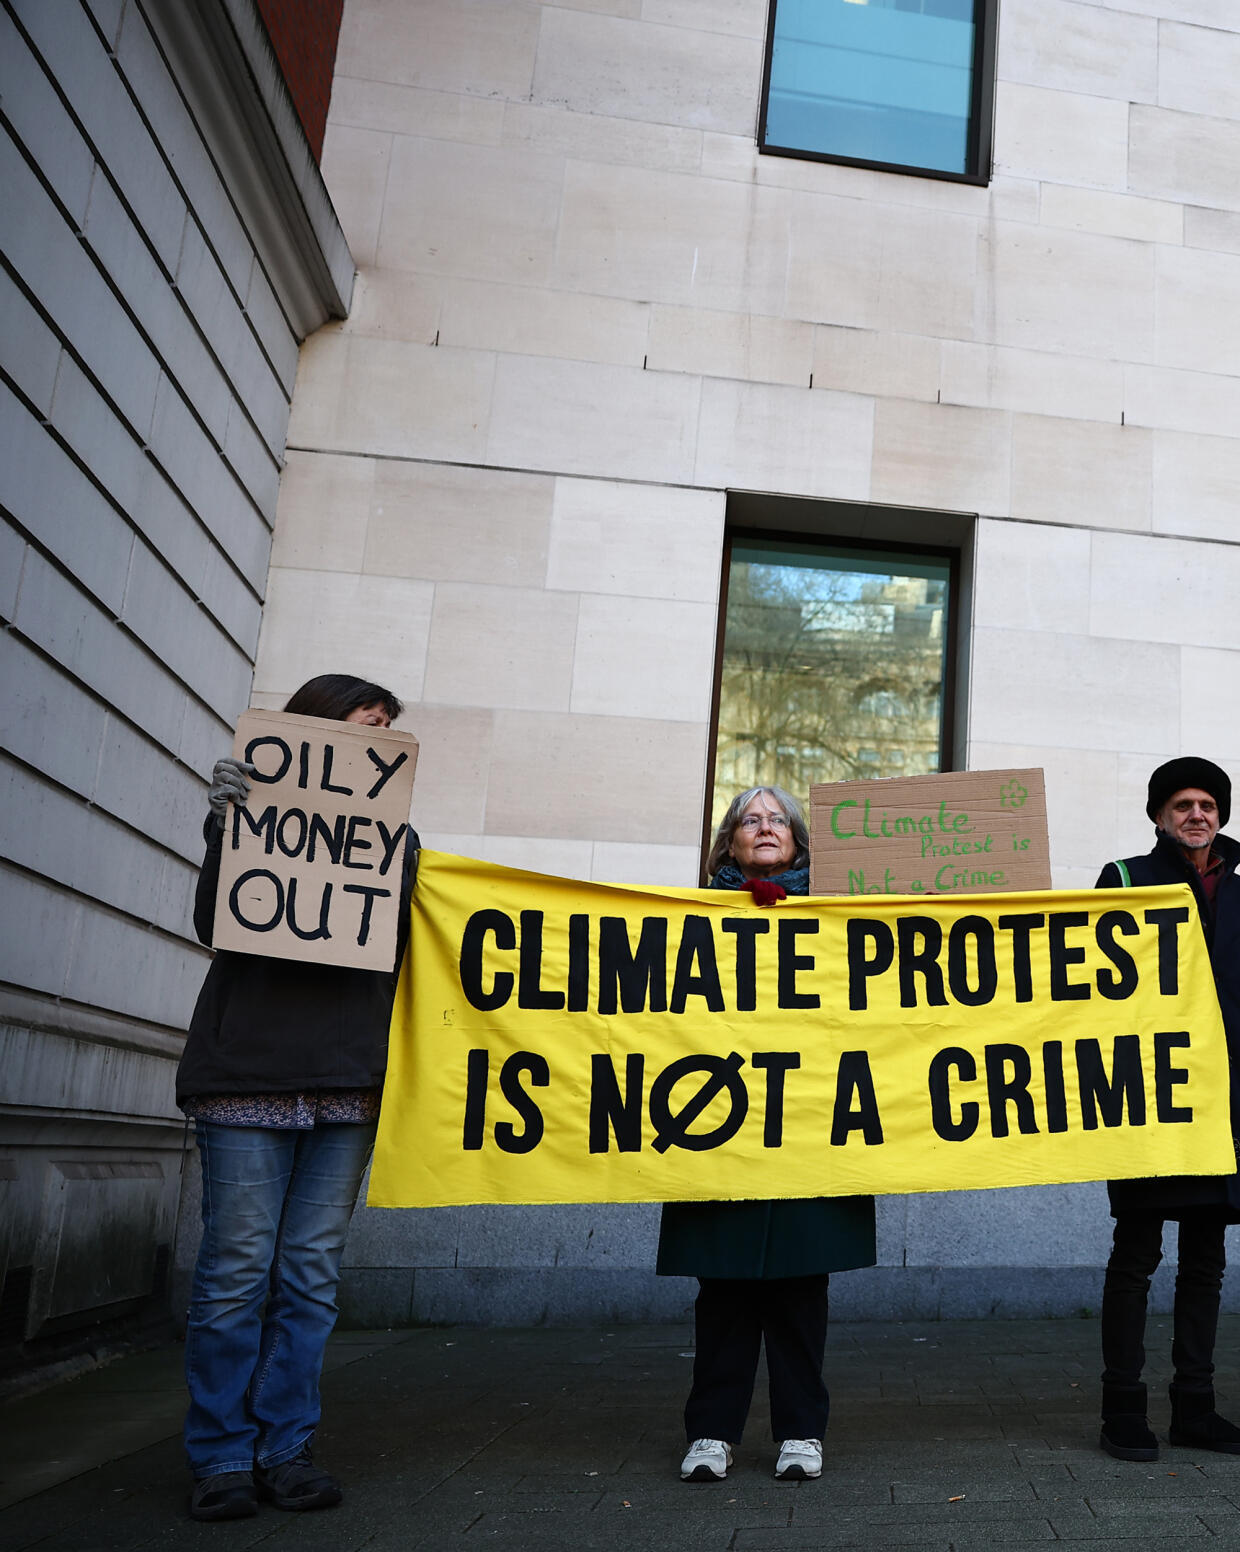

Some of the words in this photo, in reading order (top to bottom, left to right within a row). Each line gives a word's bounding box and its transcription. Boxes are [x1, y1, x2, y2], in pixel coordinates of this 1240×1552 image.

[245, 736, 408, 799] OILY
[231, 805, 408, 876] MONEY
[830, 798, 971, 839] Climate
[921, 834, 994, 859] Protest
[1012, 833, 1031, 851] is
[229, 869, 391, 946] OUT
[848, 868, 897, 896] Not
[911, 879, 925, 892] a
[935, 864, 1008, 890] Crime
[459, 908, 820, 1015] CLIMATE
[847, 907, 1189, 1010] PROTEST
[463, 1048, 549, 1154] IS
[830, 1050, 884, 1146] A
[928, 1032, 1193, 1142] CRIME
